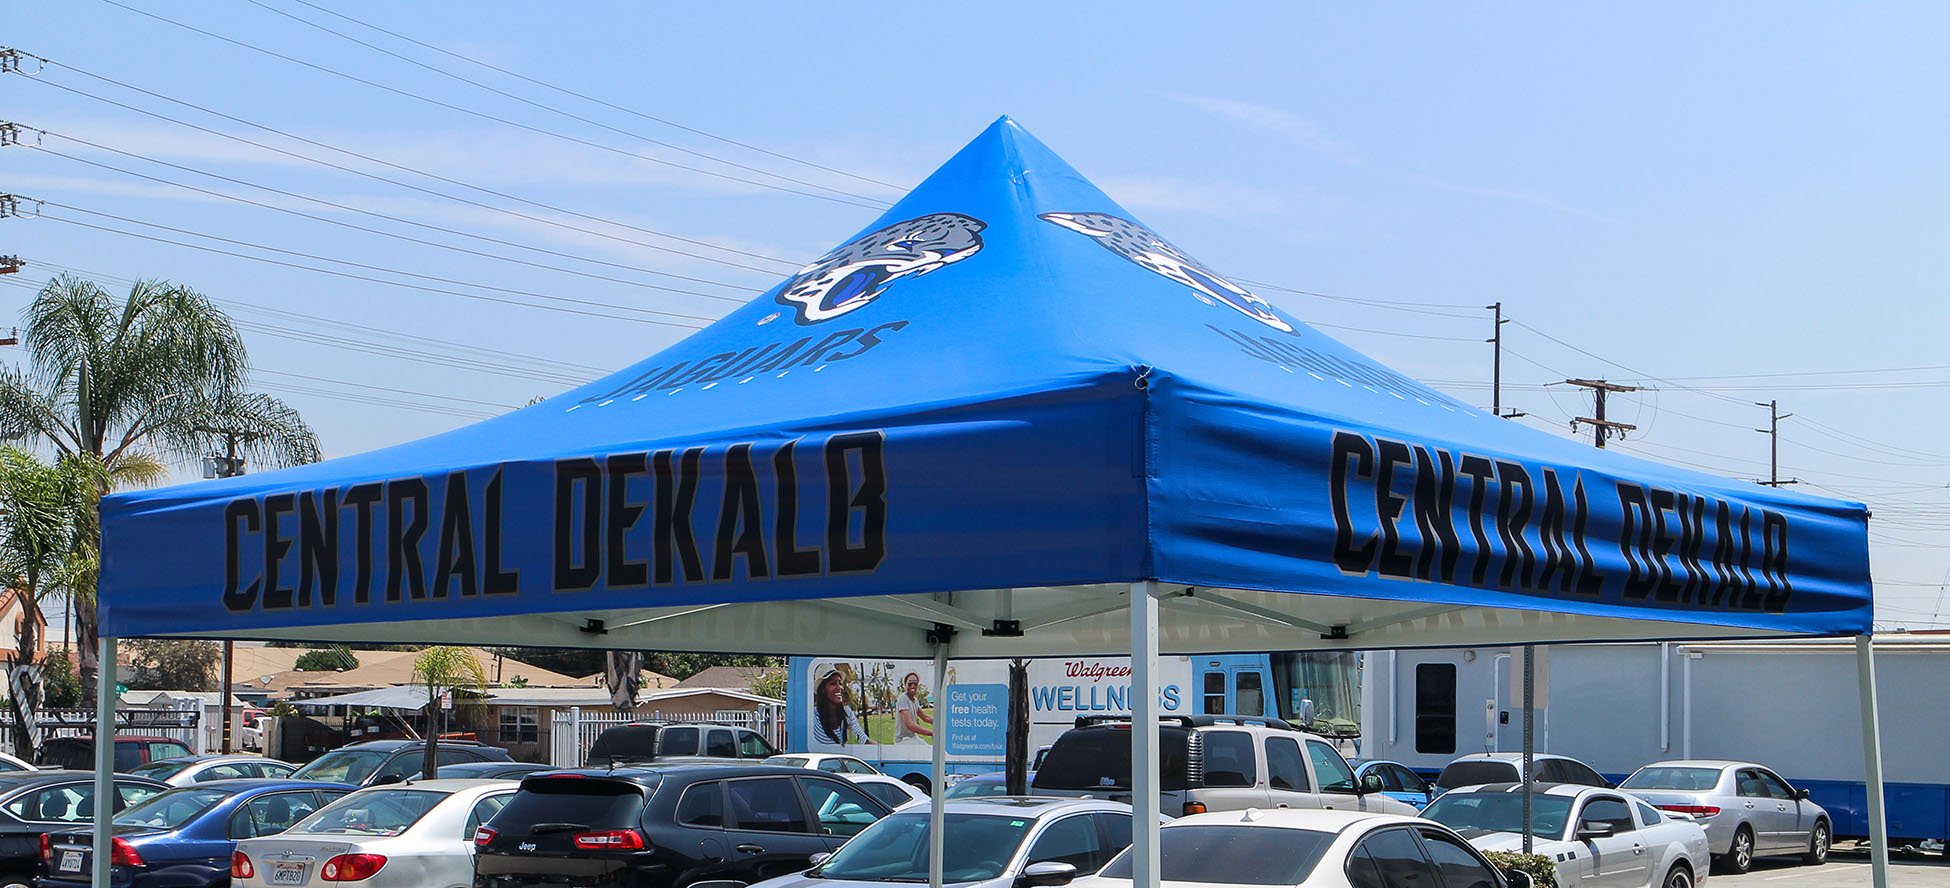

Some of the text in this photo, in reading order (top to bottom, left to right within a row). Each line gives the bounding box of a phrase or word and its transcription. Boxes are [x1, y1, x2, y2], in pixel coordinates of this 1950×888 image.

[578, 320, 910, 404] JAGUARS
[1203, 322, 1460, 409] JAGUARS
[221, 429, 888, 614] CENTRAL DEKALB
[1328, 428, 1793, 615] CENTRAL DEKALB
[1064, 660, 1132, 683] Walgree
[951, 690, 988, 704] Get your
[1032, 684, 1182, 712] WELLNS
[951, 704, 998, 714] free health
[951, 717, 1000, 730] tests today.
[951, 733, 963, 741] Find
[518, 841, 537, 852] Jeep
